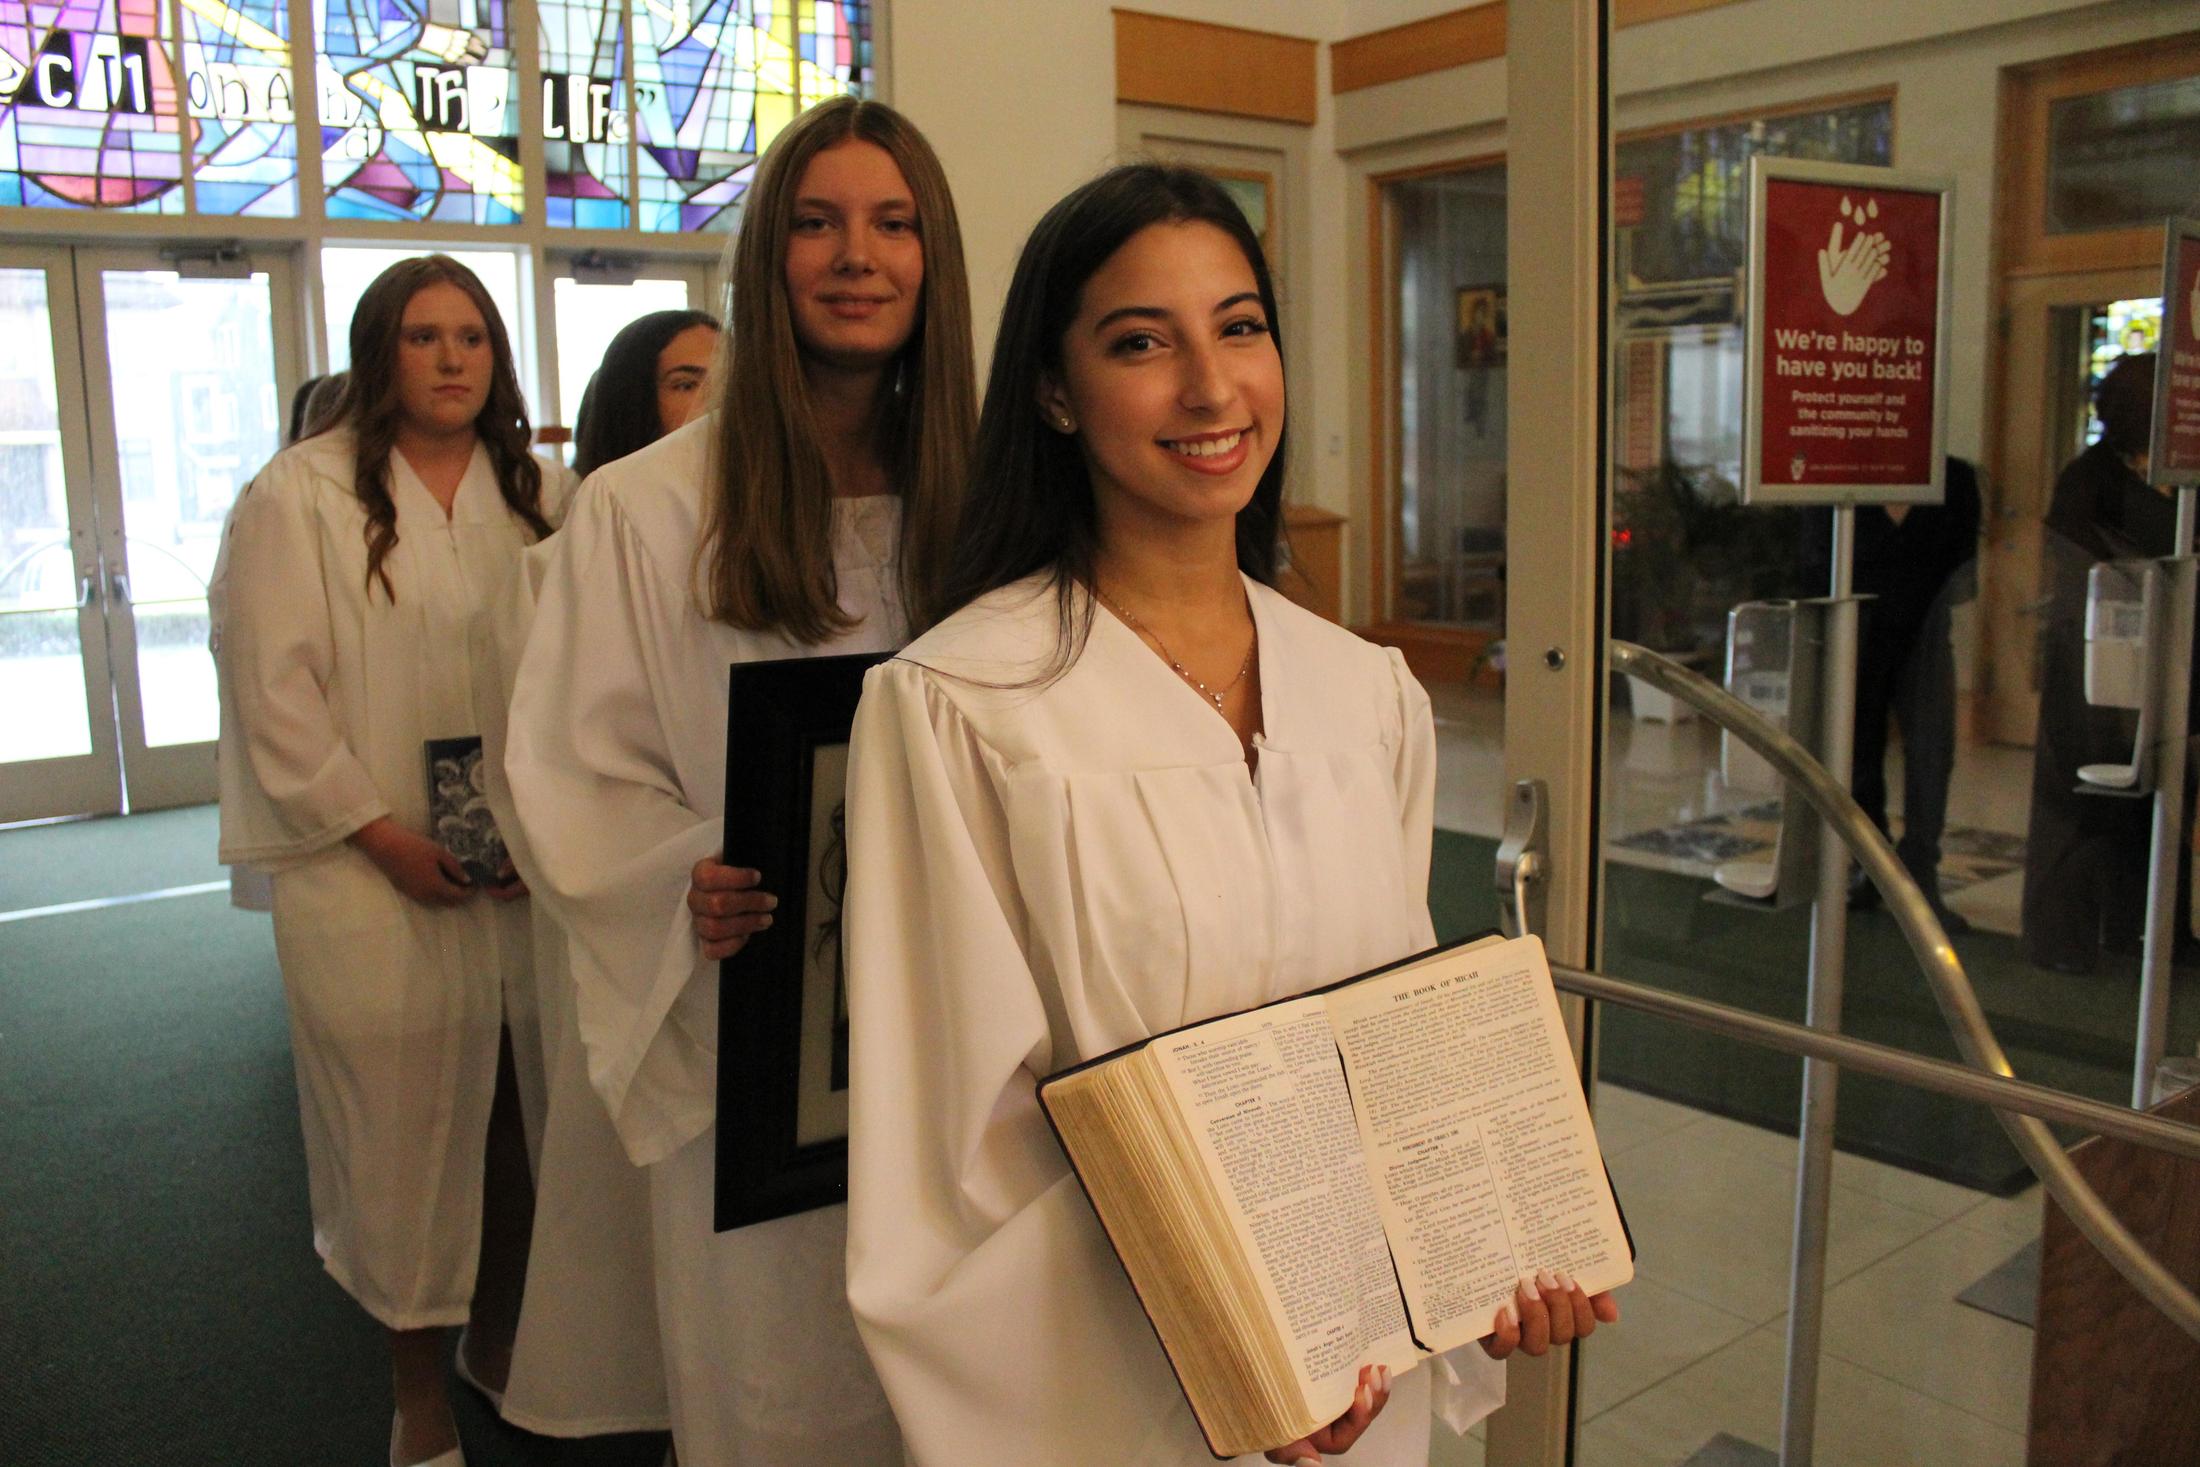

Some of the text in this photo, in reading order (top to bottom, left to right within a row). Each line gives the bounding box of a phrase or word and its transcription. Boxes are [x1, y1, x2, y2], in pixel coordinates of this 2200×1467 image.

[1775, 328, 1924, 357] We're happy to
[1776, 354, 1923, 382] have you back!
[1791, 390, 1906, 406] Protect yourself and
[1797, 408, 1899, 423] the community by
[1789, 425, 1846, 440] sanitizing
[1848, 427, 1873, 439] your
[1392, 971, 1479, 1003] THE BOOK OF MICAH
